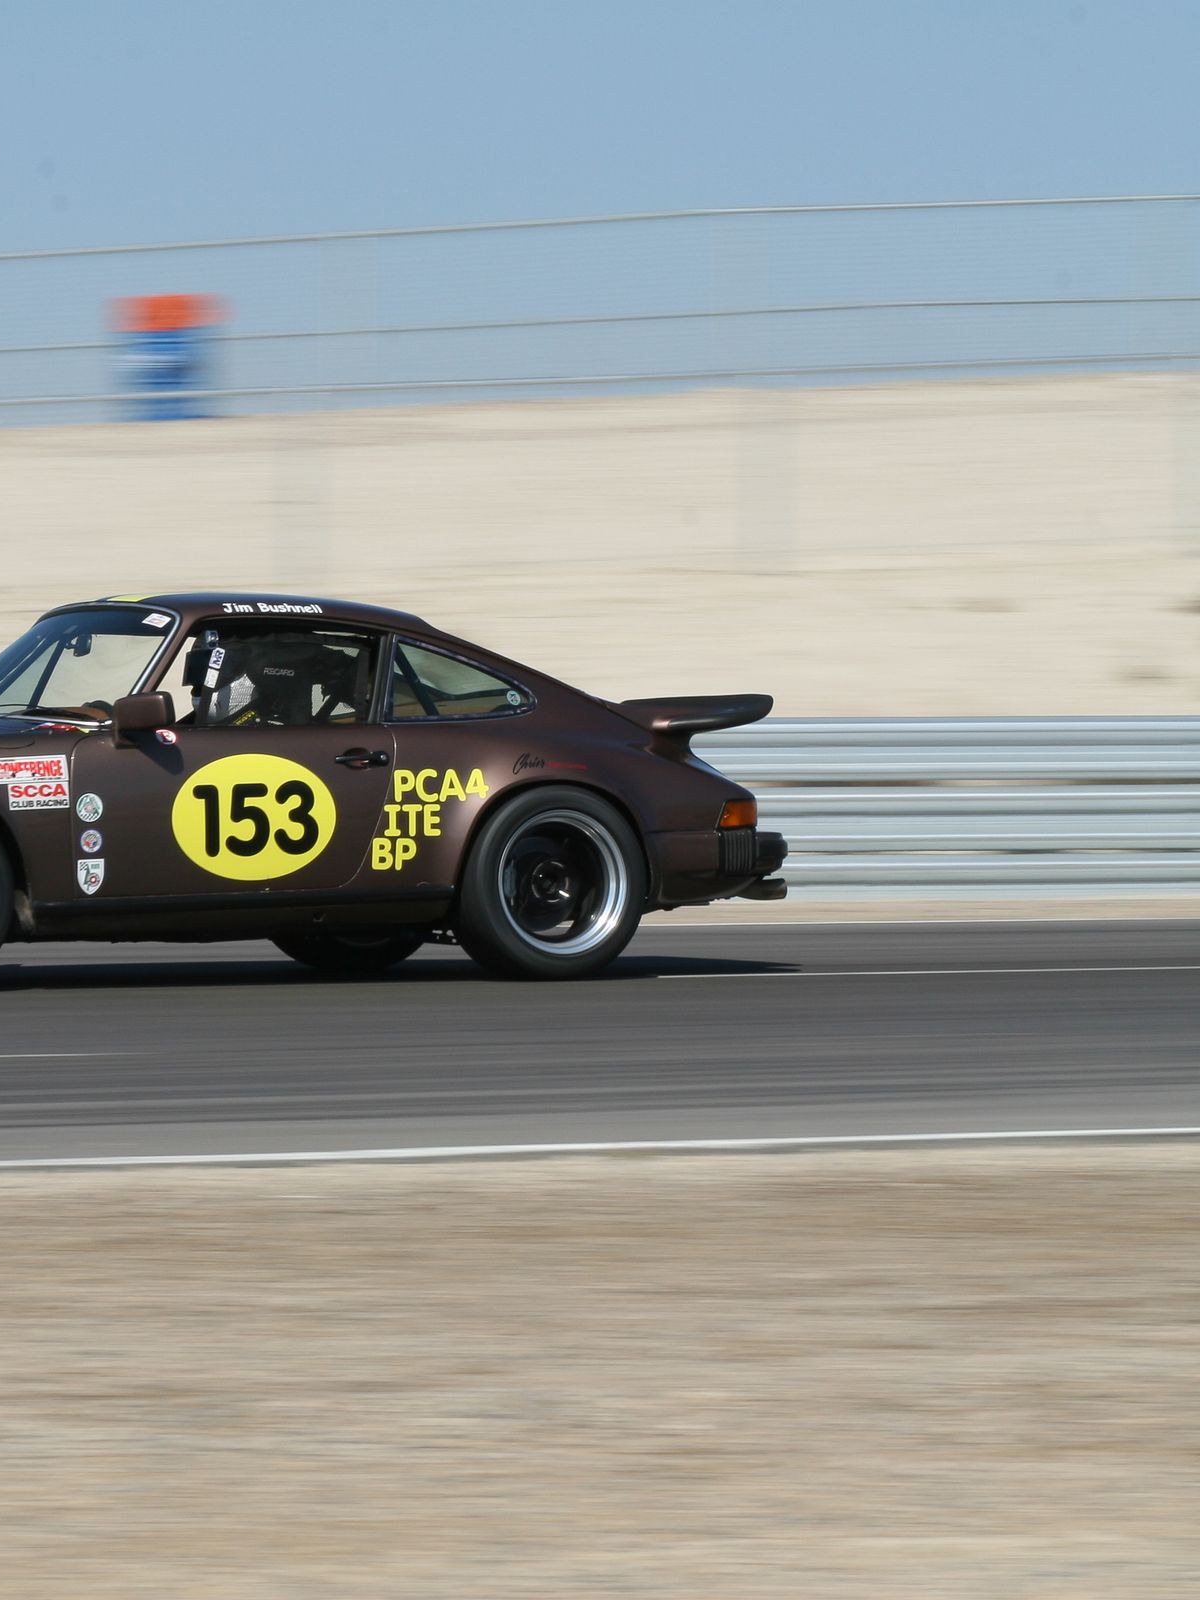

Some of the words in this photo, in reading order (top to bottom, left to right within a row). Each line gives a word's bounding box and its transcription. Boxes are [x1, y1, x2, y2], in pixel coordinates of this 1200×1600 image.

[222, 602, 253, 613] Jim
[257, 602, 323, 614] Bushnell
[10, 783, 67, 798] SCCA
[393, 768, 490, 803] PCA4
[11, 800, 35, 808] CLUB
[36, 798, 68, 808] RACING
[192, 779, 319, 858] 153
[383, 803, 442, 837] ITE
[371, 837, 417, 871] BP
